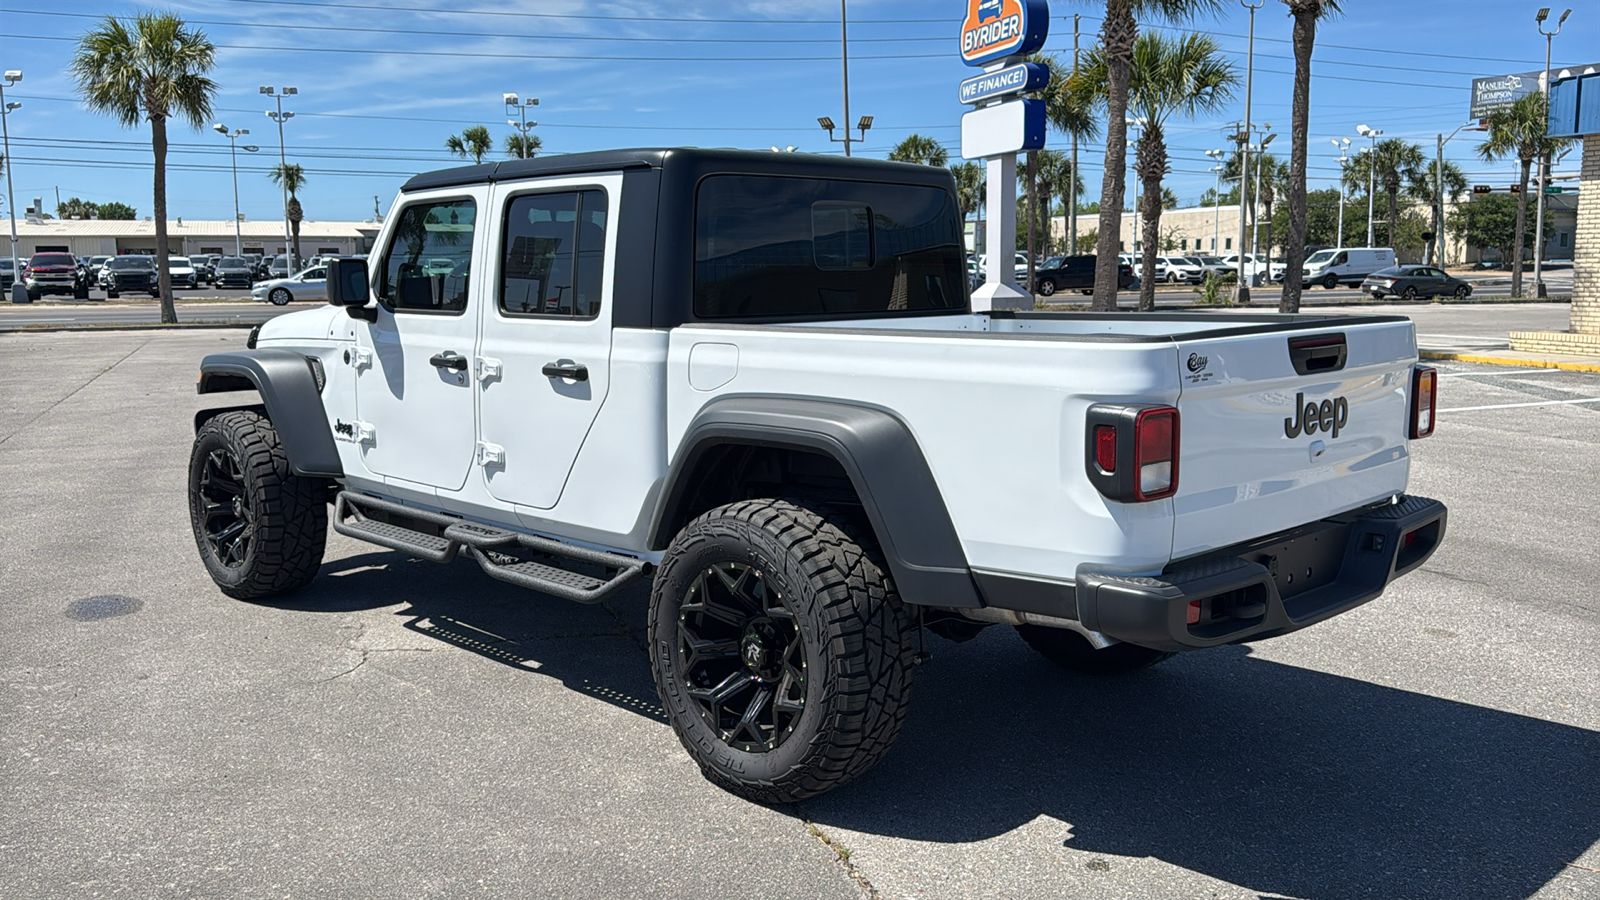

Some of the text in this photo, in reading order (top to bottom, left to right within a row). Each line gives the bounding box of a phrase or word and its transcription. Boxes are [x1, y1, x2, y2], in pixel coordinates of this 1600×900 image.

[964, 14, 1019, 52] BYRIDER
[962, 70, 1023, 98] WE FINANCE!
[1476, 90, 1512, 101] THOMPSON
[334, 418, 353, 438] Jeep
[1284, 392, 1348, 439] Jeep
